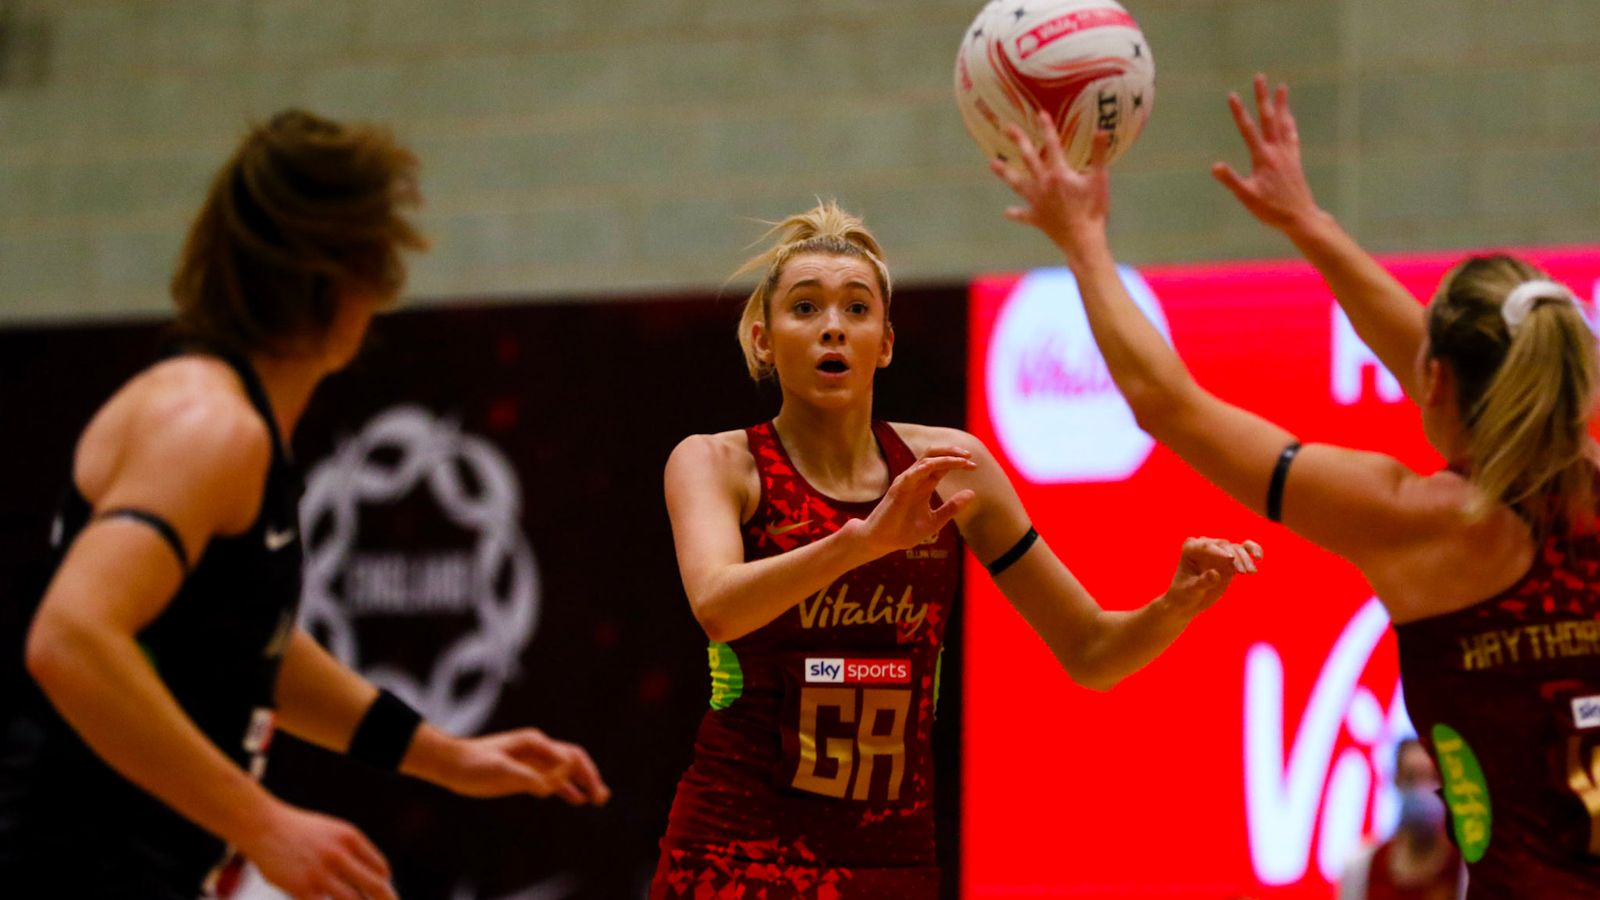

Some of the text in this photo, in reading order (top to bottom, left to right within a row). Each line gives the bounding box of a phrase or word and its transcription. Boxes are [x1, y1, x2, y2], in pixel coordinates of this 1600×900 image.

[799, 583, 929, 639] Vitality
[810, 661, 907, 680] sky sports
[791, 687, 912, 801] GA
